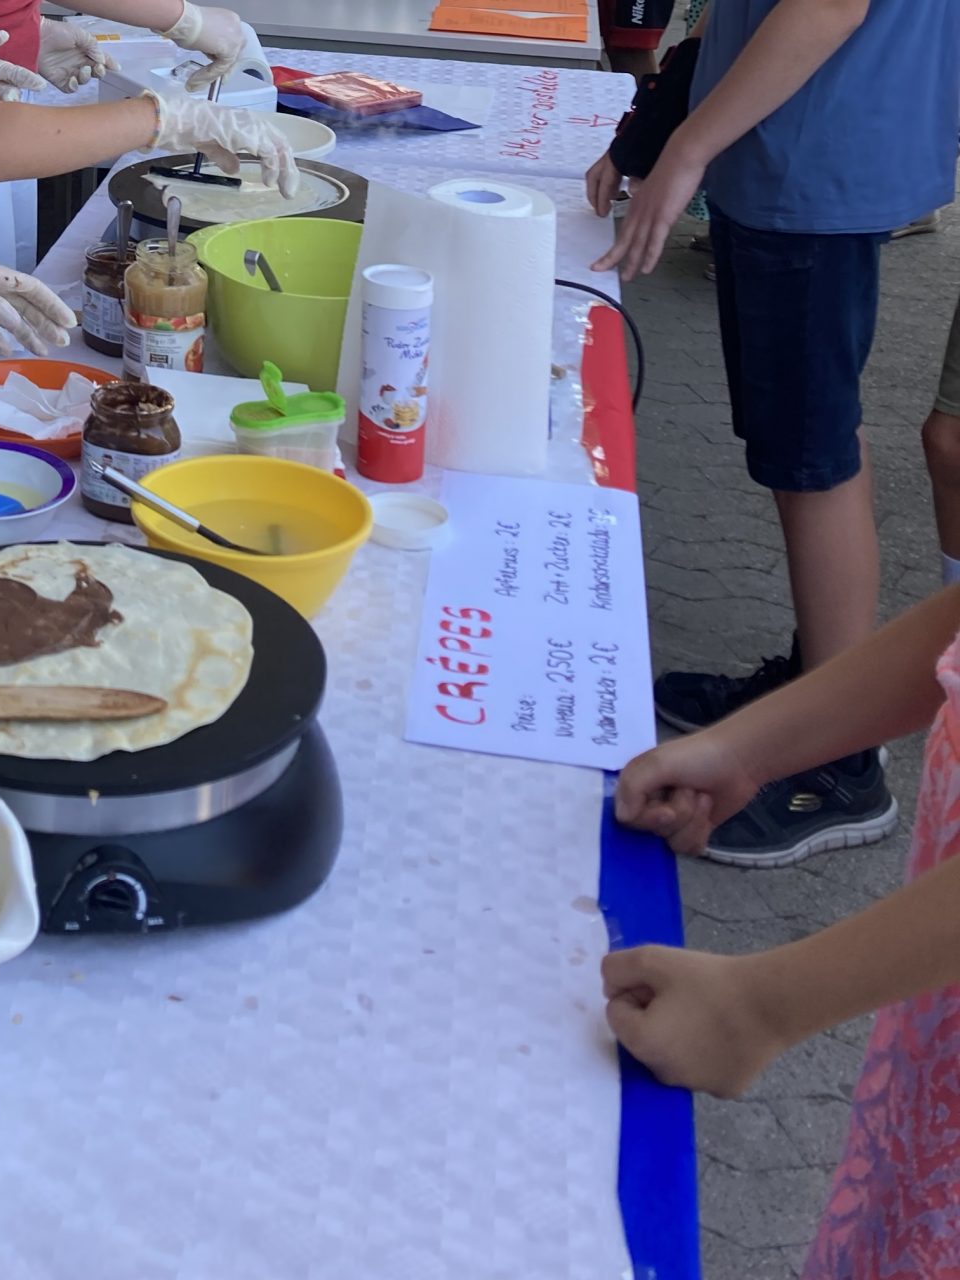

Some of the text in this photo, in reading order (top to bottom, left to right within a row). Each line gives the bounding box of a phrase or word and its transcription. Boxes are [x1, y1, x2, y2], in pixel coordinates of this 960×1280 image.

[509, 112, 548, 135] hier
[546, 637, 576, 685] 2,50€
[588, 641, 619, 666] 2€
